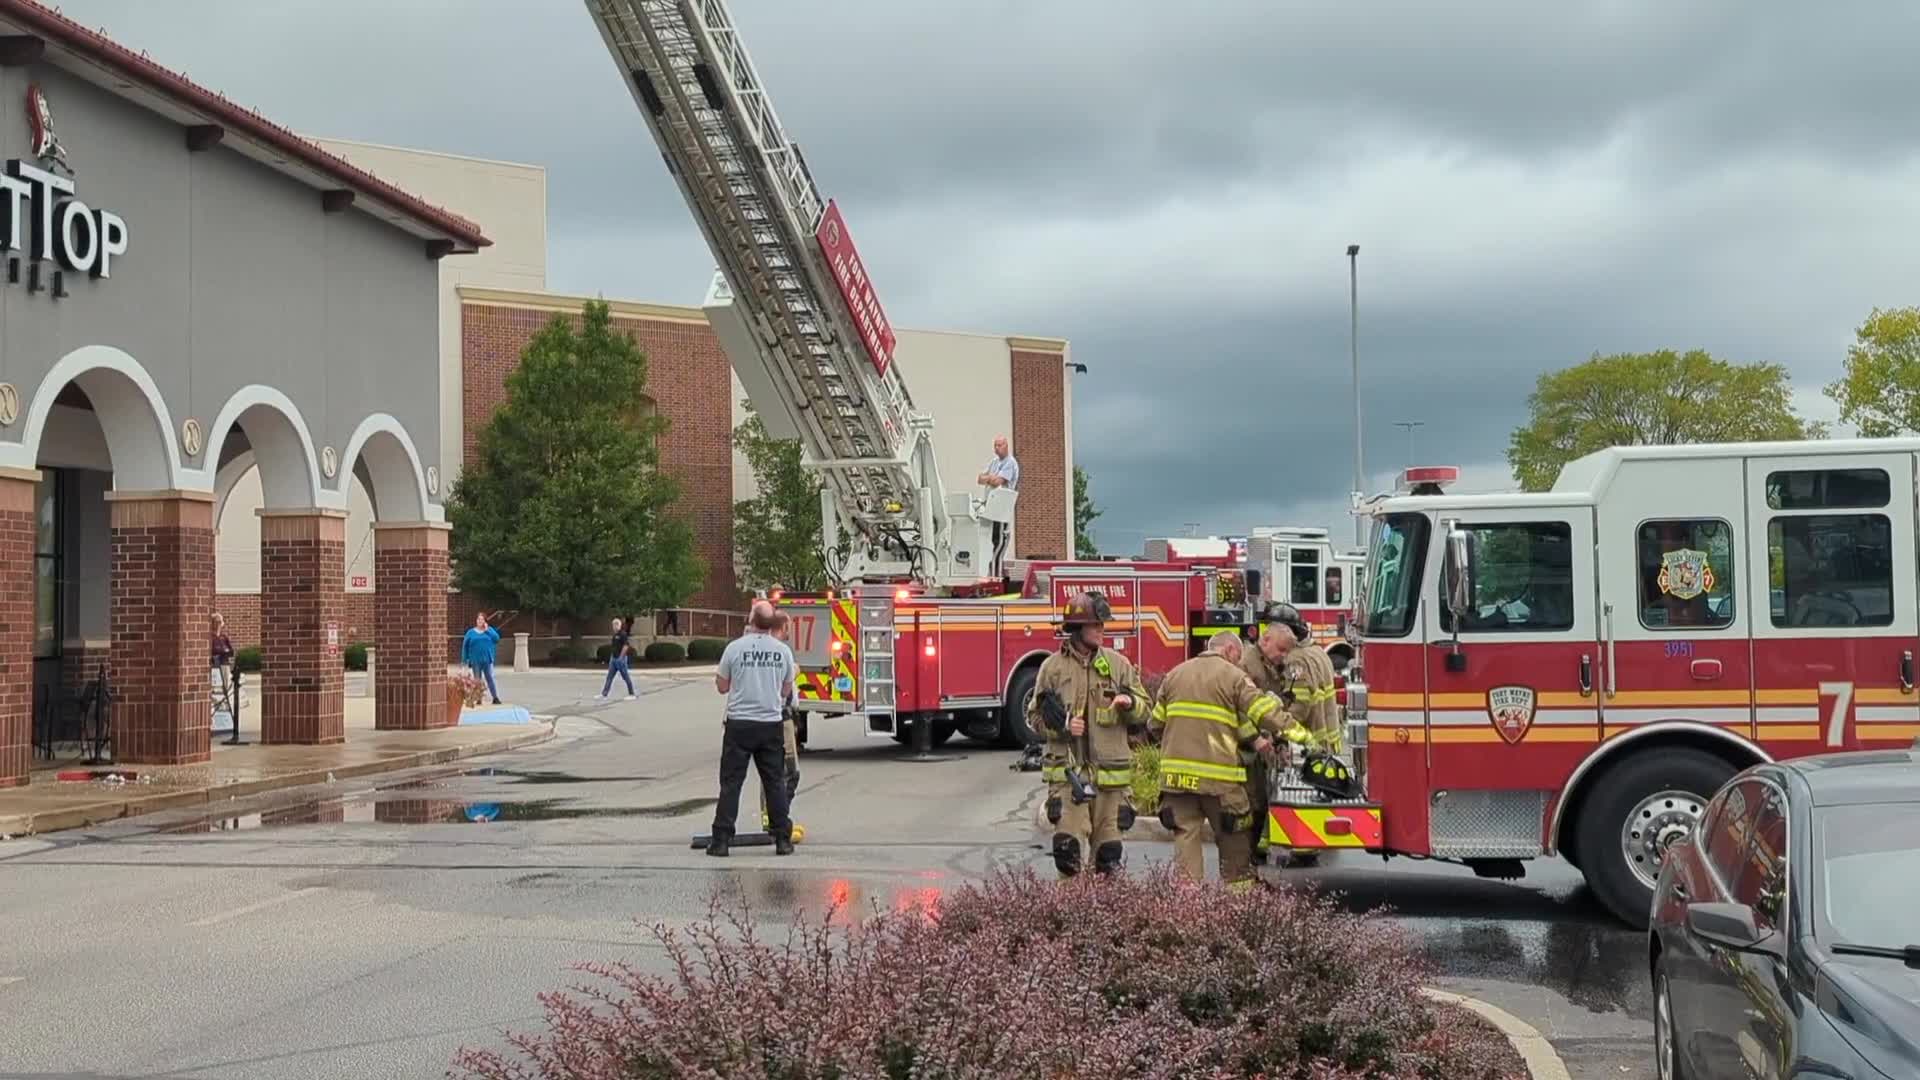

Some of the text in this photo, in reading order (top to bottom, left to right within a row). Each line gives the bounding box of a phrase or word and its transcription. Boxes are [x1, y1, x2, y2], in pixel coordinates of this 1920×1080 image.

[834, 253, 888, 368] FIRE DEPARTMENT
[848, 252, 886, 336] FORT WAYNE
[1109, 585, 1126, 598] FIRE
[743, 651, 782, 661] FWFD
[792, 616, 816, 651] 17
[1818, 682, 1854, 747] 7
